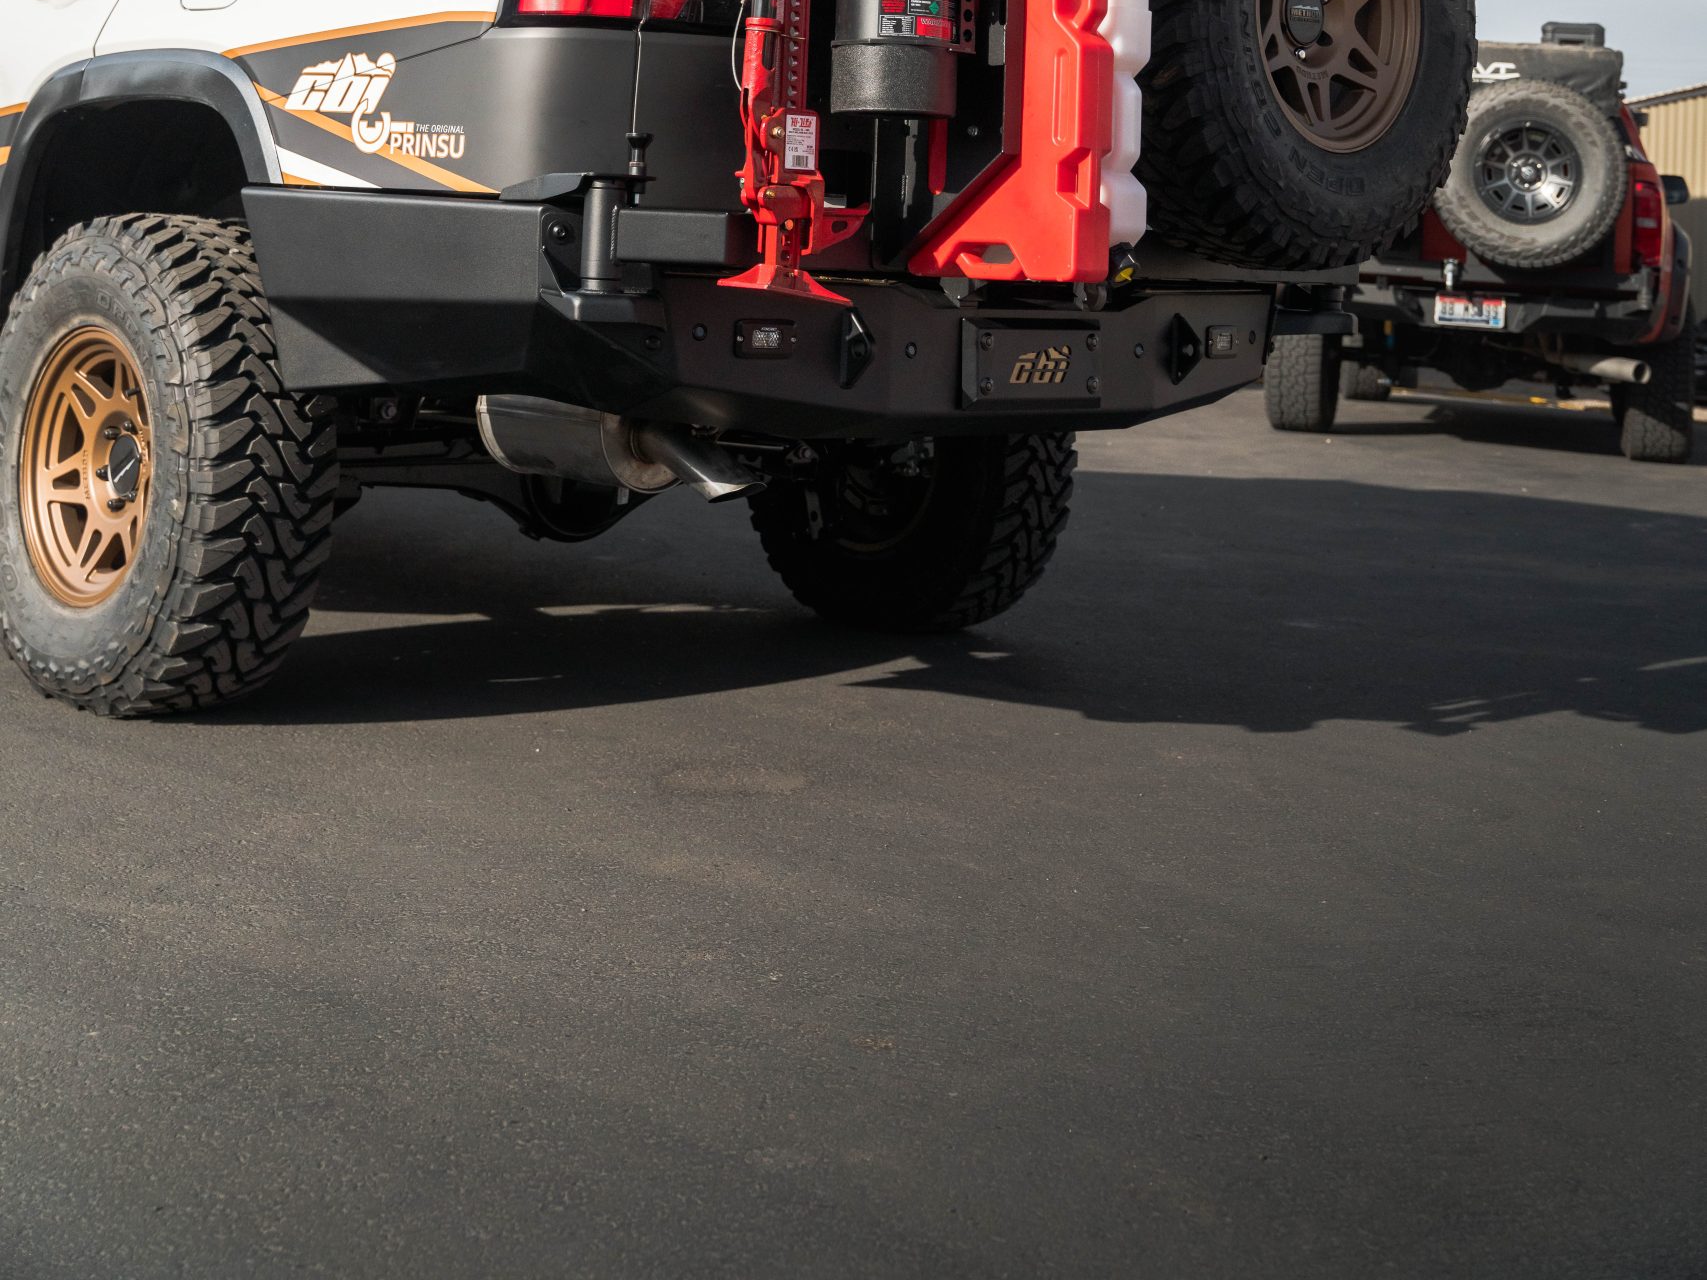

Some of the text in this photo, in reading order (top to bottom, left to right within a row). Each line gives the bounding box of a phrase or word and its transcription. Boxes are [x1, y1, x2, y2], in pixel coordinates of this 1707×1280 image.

[416, 123, 465, 134] THE ORIGINAL
[390, 132, 466, 160] PRINSU
